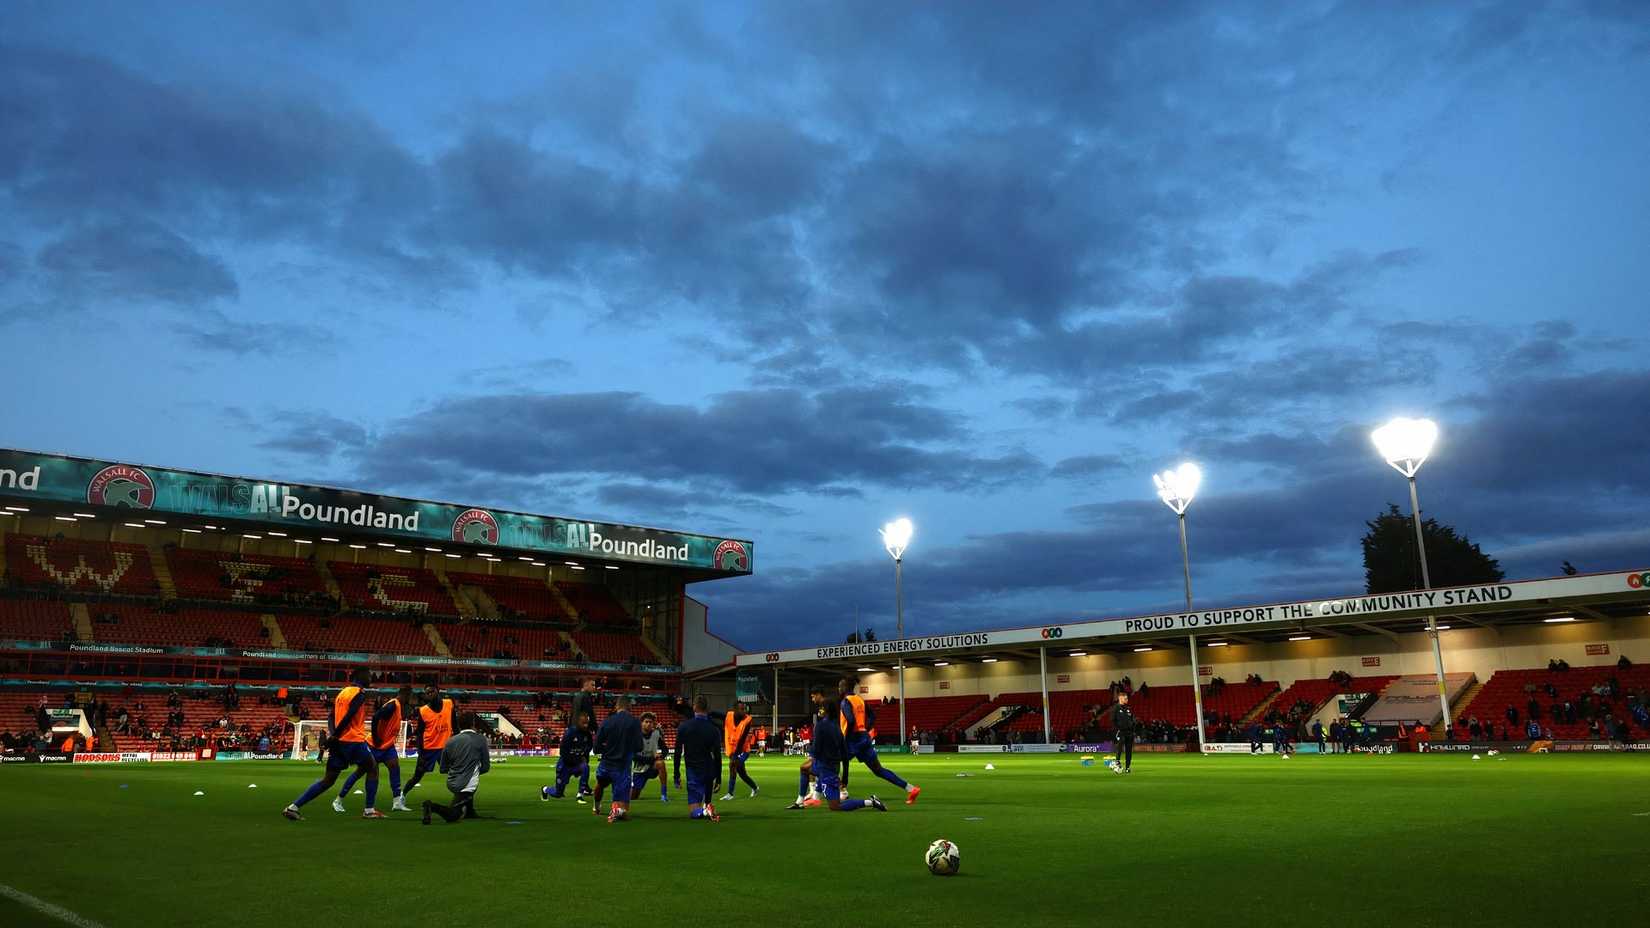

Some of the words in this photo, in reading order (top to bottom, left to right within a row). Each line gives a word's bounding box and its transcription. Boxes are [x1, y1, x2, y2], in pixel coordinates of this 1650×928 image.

[93, 468, 127, 492] WALSALL
[282, 495, 419, 532] Poundland
[588, 532, 688, 561] Poundland
[1126, 617, 1174, 632] PROUD
[1178, 614, 1199, 627] TO
[1204, 607, 1274, 625] SUPPORT
[1282, 603, 1313, 618] THE
[1321, 592, 1436, 616] COMMUNITY
[1444, 585, 1512, 605] STAND
[817, 643, 880, 659] EXPERIENCED
[884, 638, 924, 655] ENERGY
[926, 633, 988, 650] SOLUTIONS
[821, 783, 827, 798] 7
